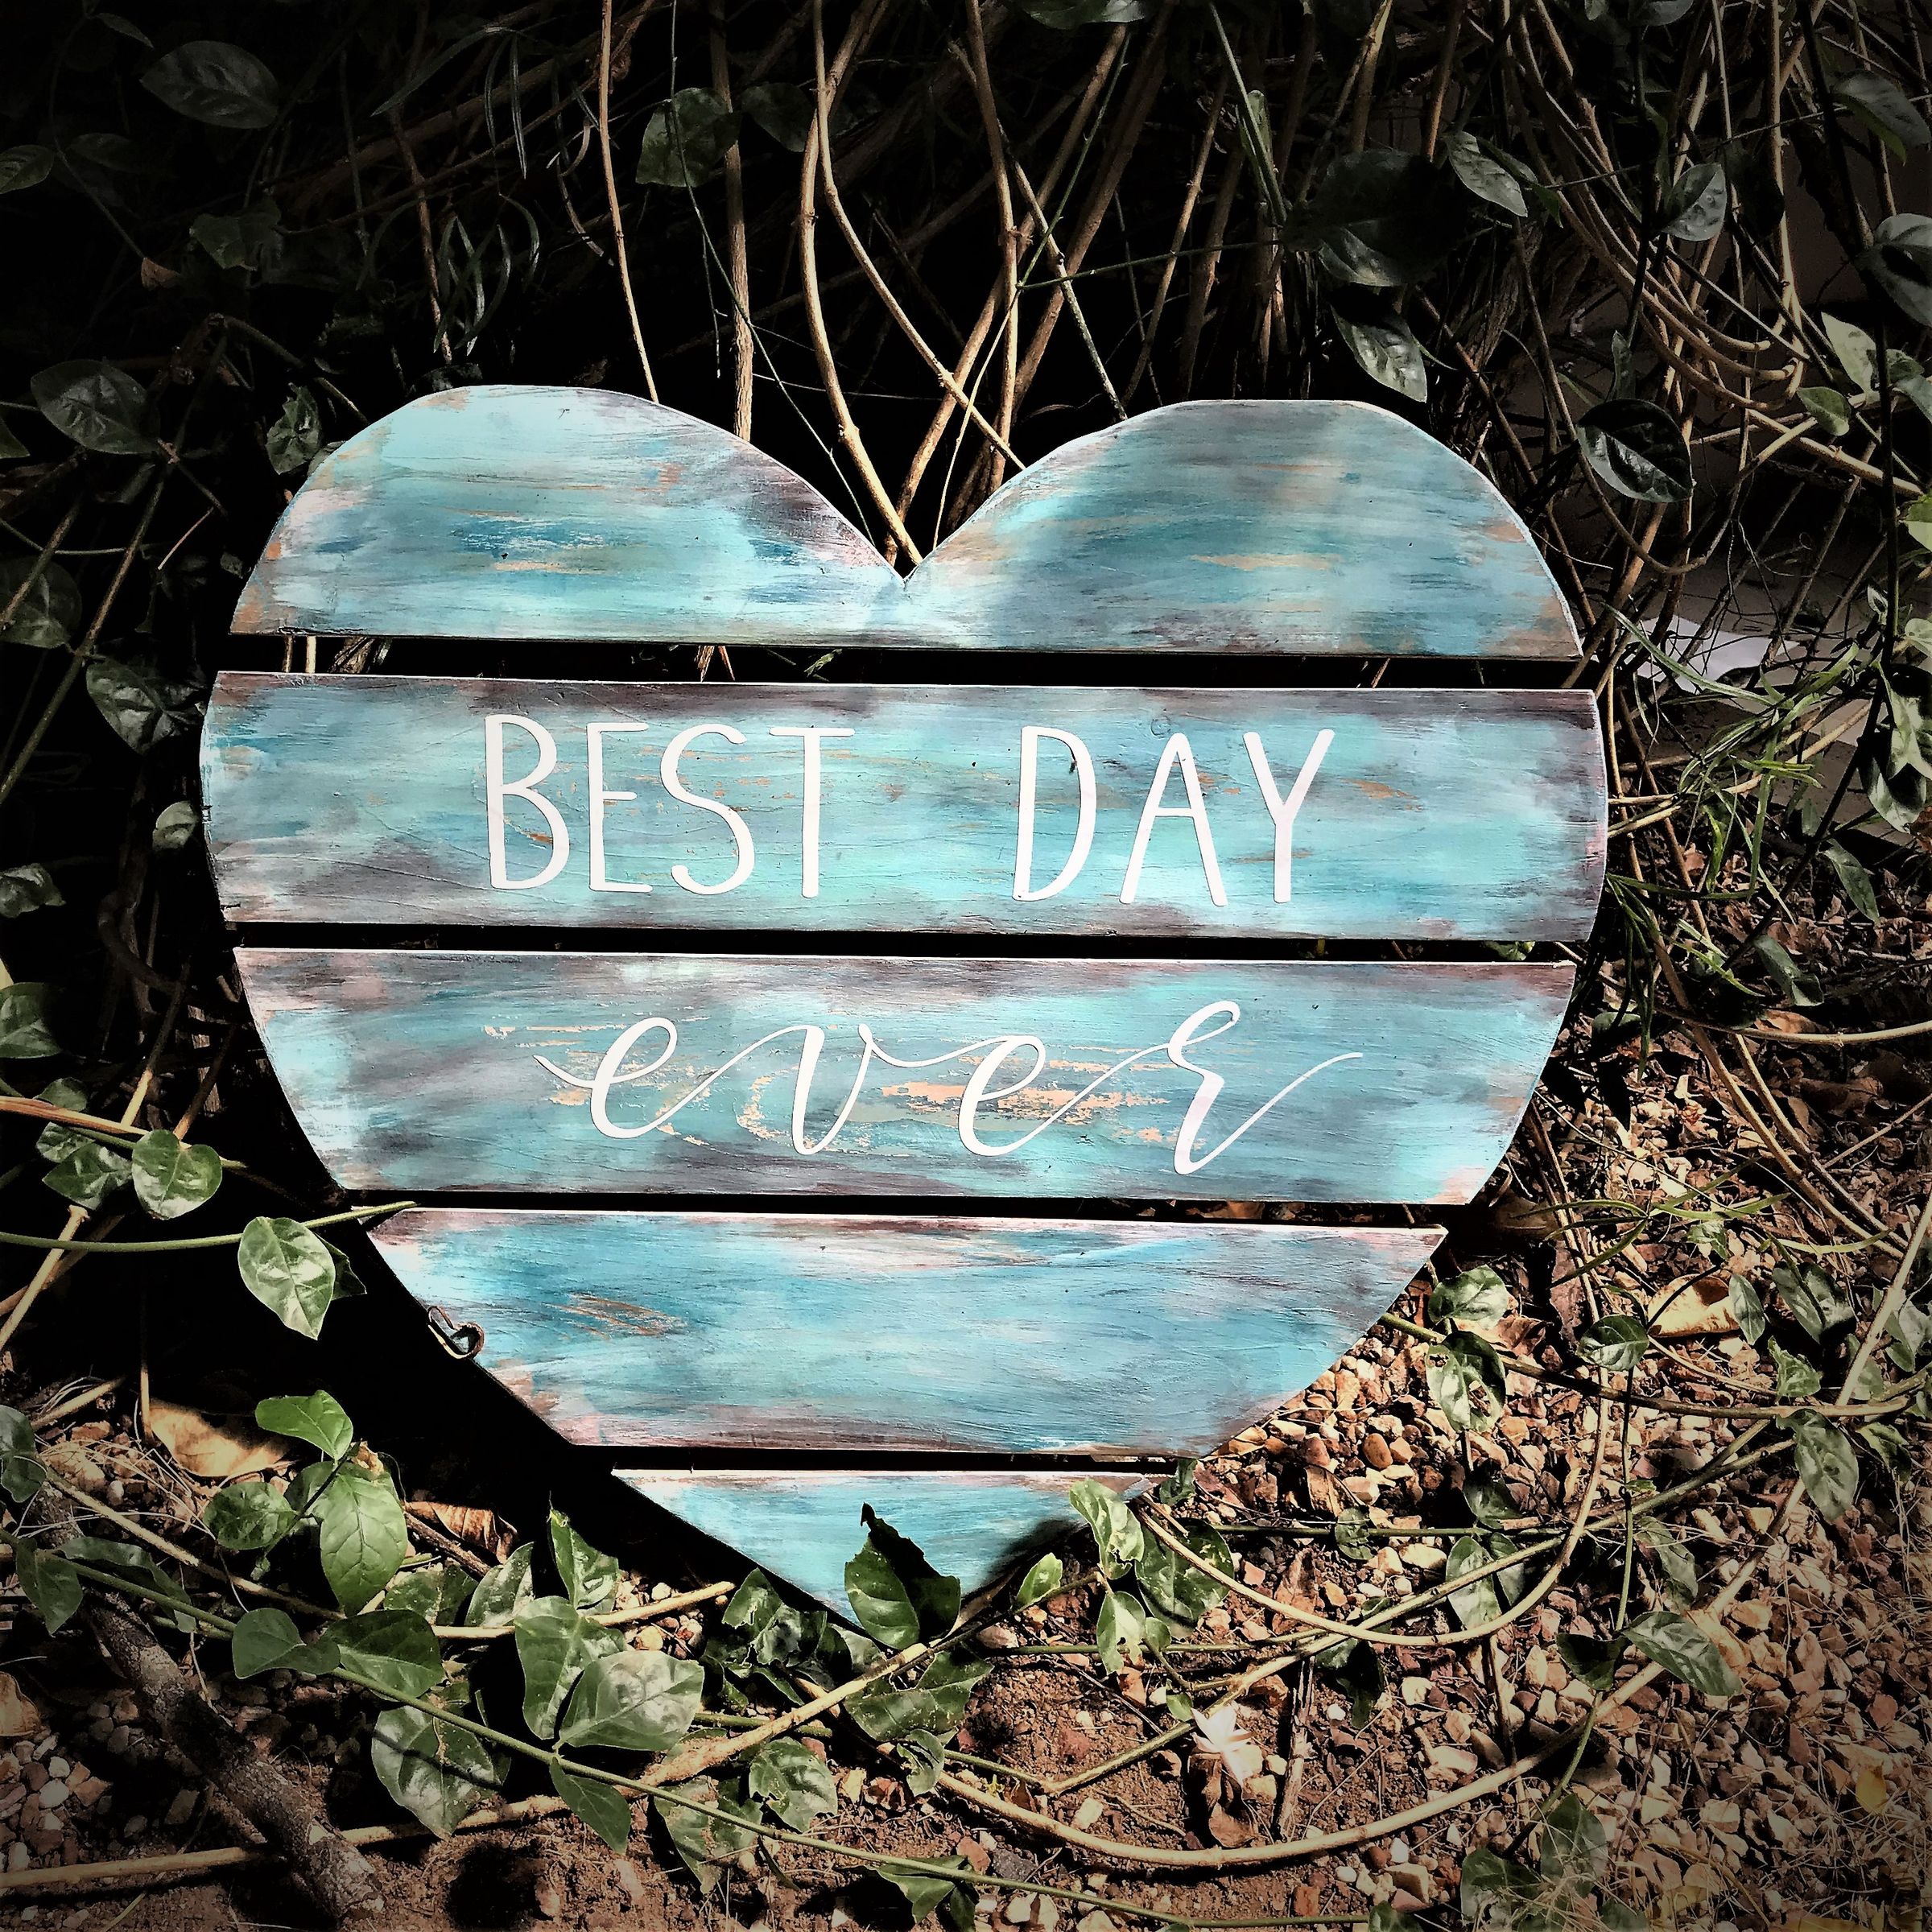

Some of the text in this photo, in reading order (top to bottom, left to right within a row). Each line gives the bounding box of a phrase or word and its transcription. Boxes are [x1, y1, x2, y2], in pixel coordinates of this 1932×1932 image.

[485, 714, 1335, 906] BEST DAY
[533, 1001, 1363, 1174] ever
